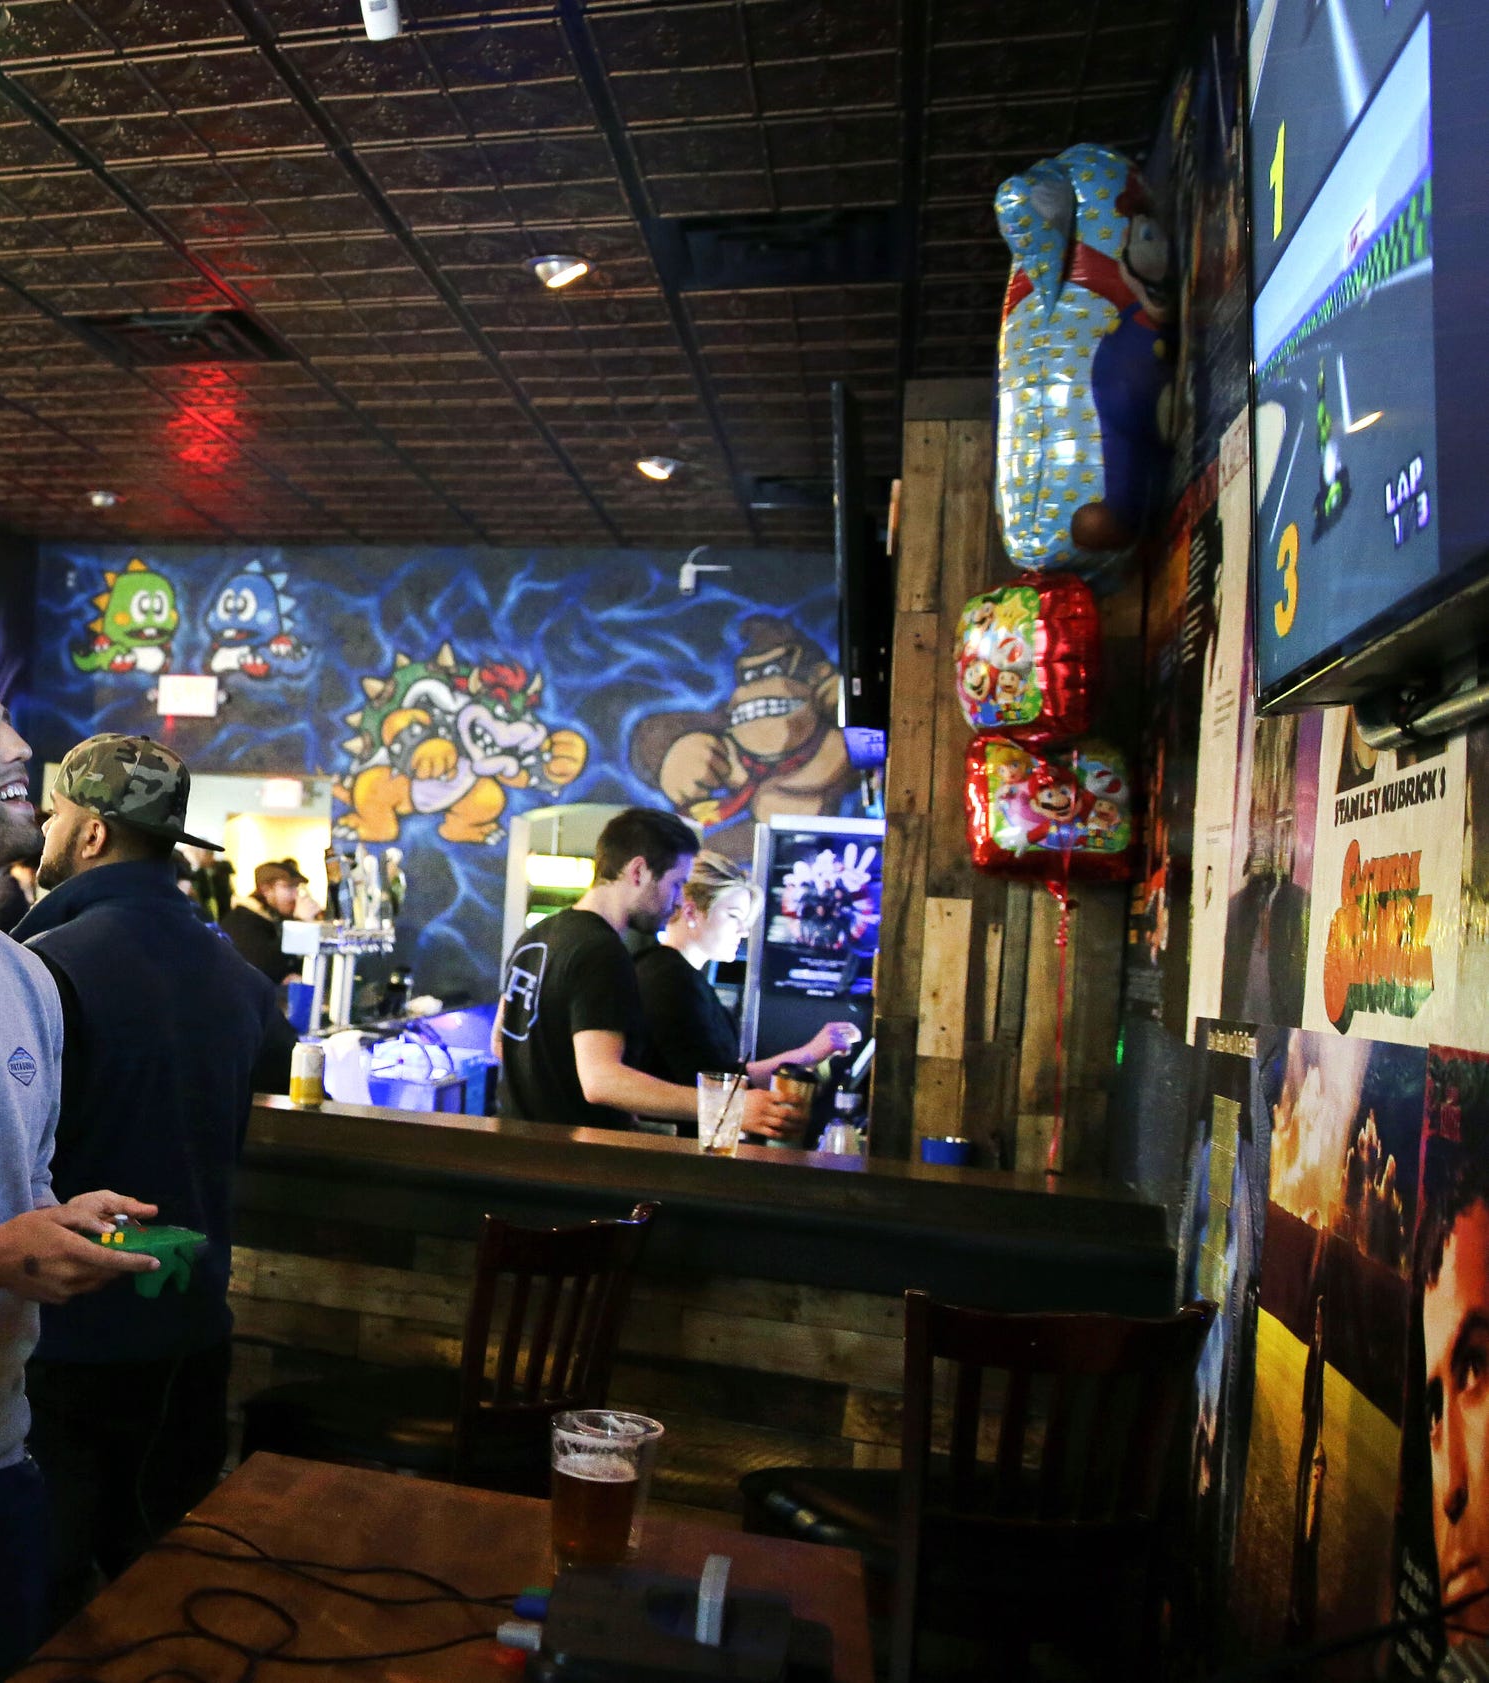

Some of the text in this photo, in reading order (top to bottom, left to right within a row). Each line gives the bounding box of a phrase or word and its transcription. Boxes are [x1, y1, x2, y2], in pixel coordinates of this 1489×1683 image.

[1269, 120, 1285, 241] 1
[1385, 456, 1423, 515] LAP
[1275, 522, 1299, 637] 3
[1334, 766, 1446, 828] STANLEY KUBRICK'S
